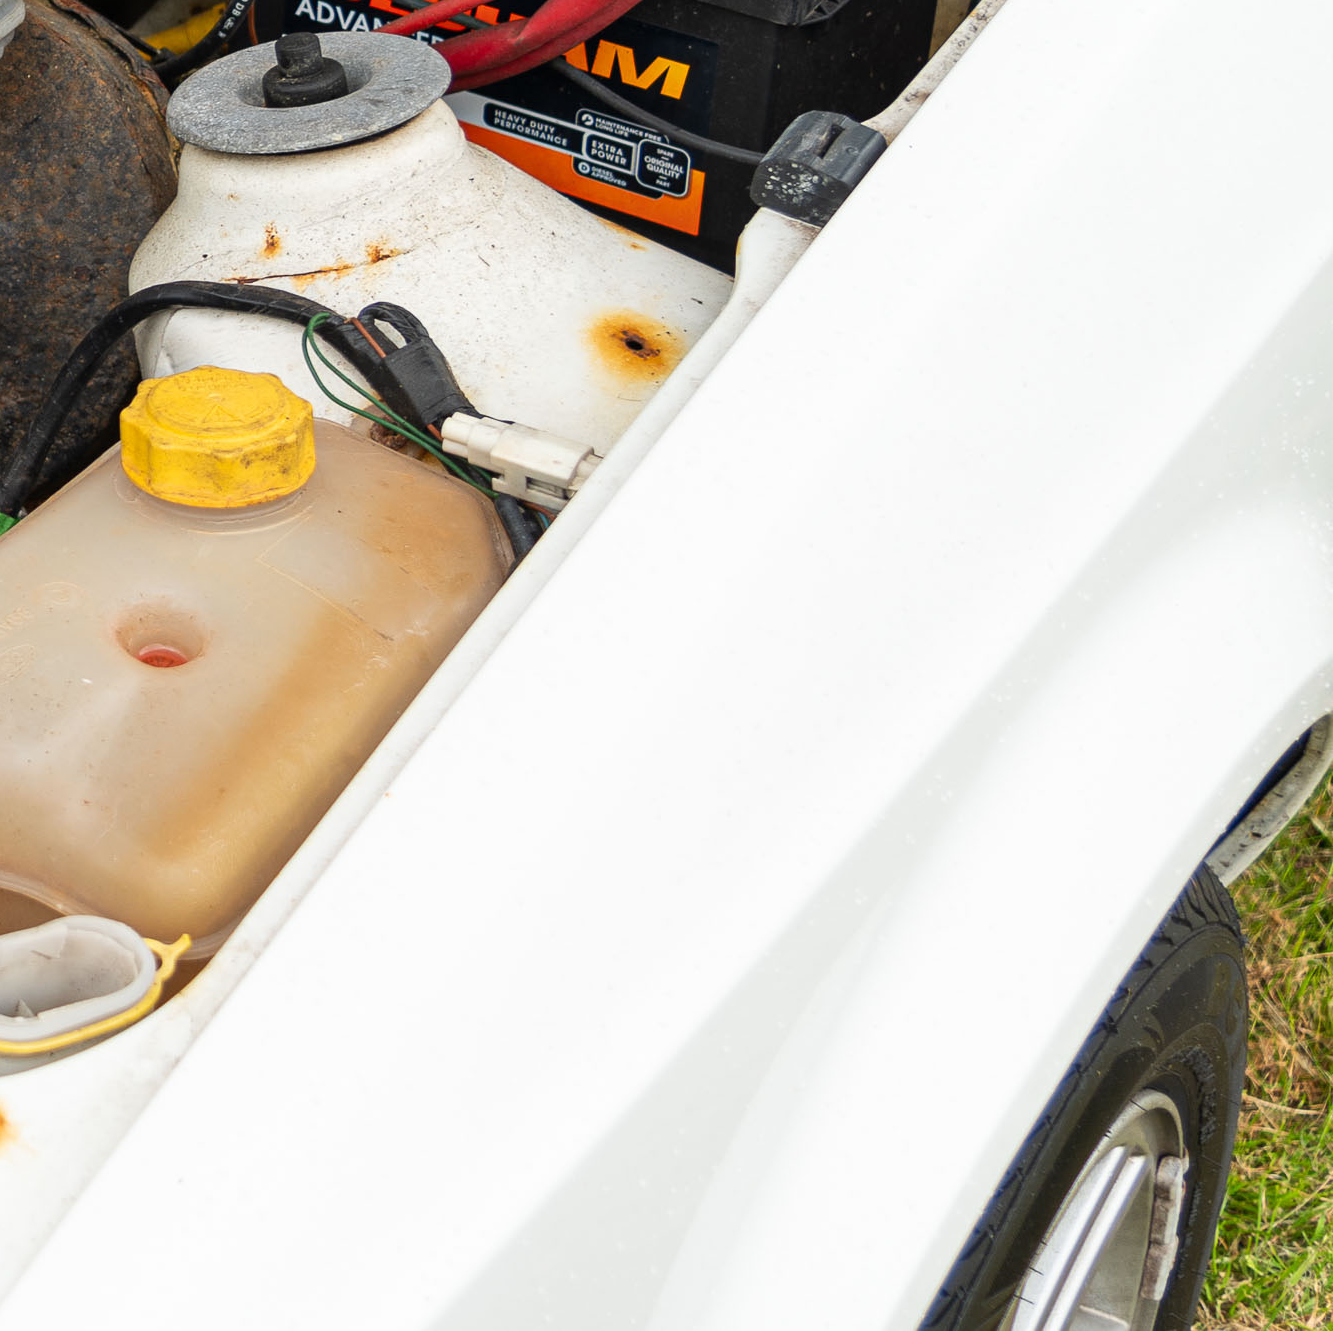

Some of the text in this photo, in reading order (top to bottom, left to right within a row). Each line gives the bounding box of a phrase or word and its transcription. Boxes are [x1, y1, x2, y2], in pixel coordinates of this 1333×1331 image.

[494, 109, 555, 134] HEAVY DUTY
[595, 117, 662, 142] MAINTENANCE FREE
[595, 123, 629, 138] LONG LIFE
[494, 118, 568, 147] PERFORMANCE
[591, 140, 624, 157] EXTRA
[591, 148, 627, 166] POWER
[644, 155, 684, 174] ORIGINAL
[646, 164, 681, 179] QUALITY
